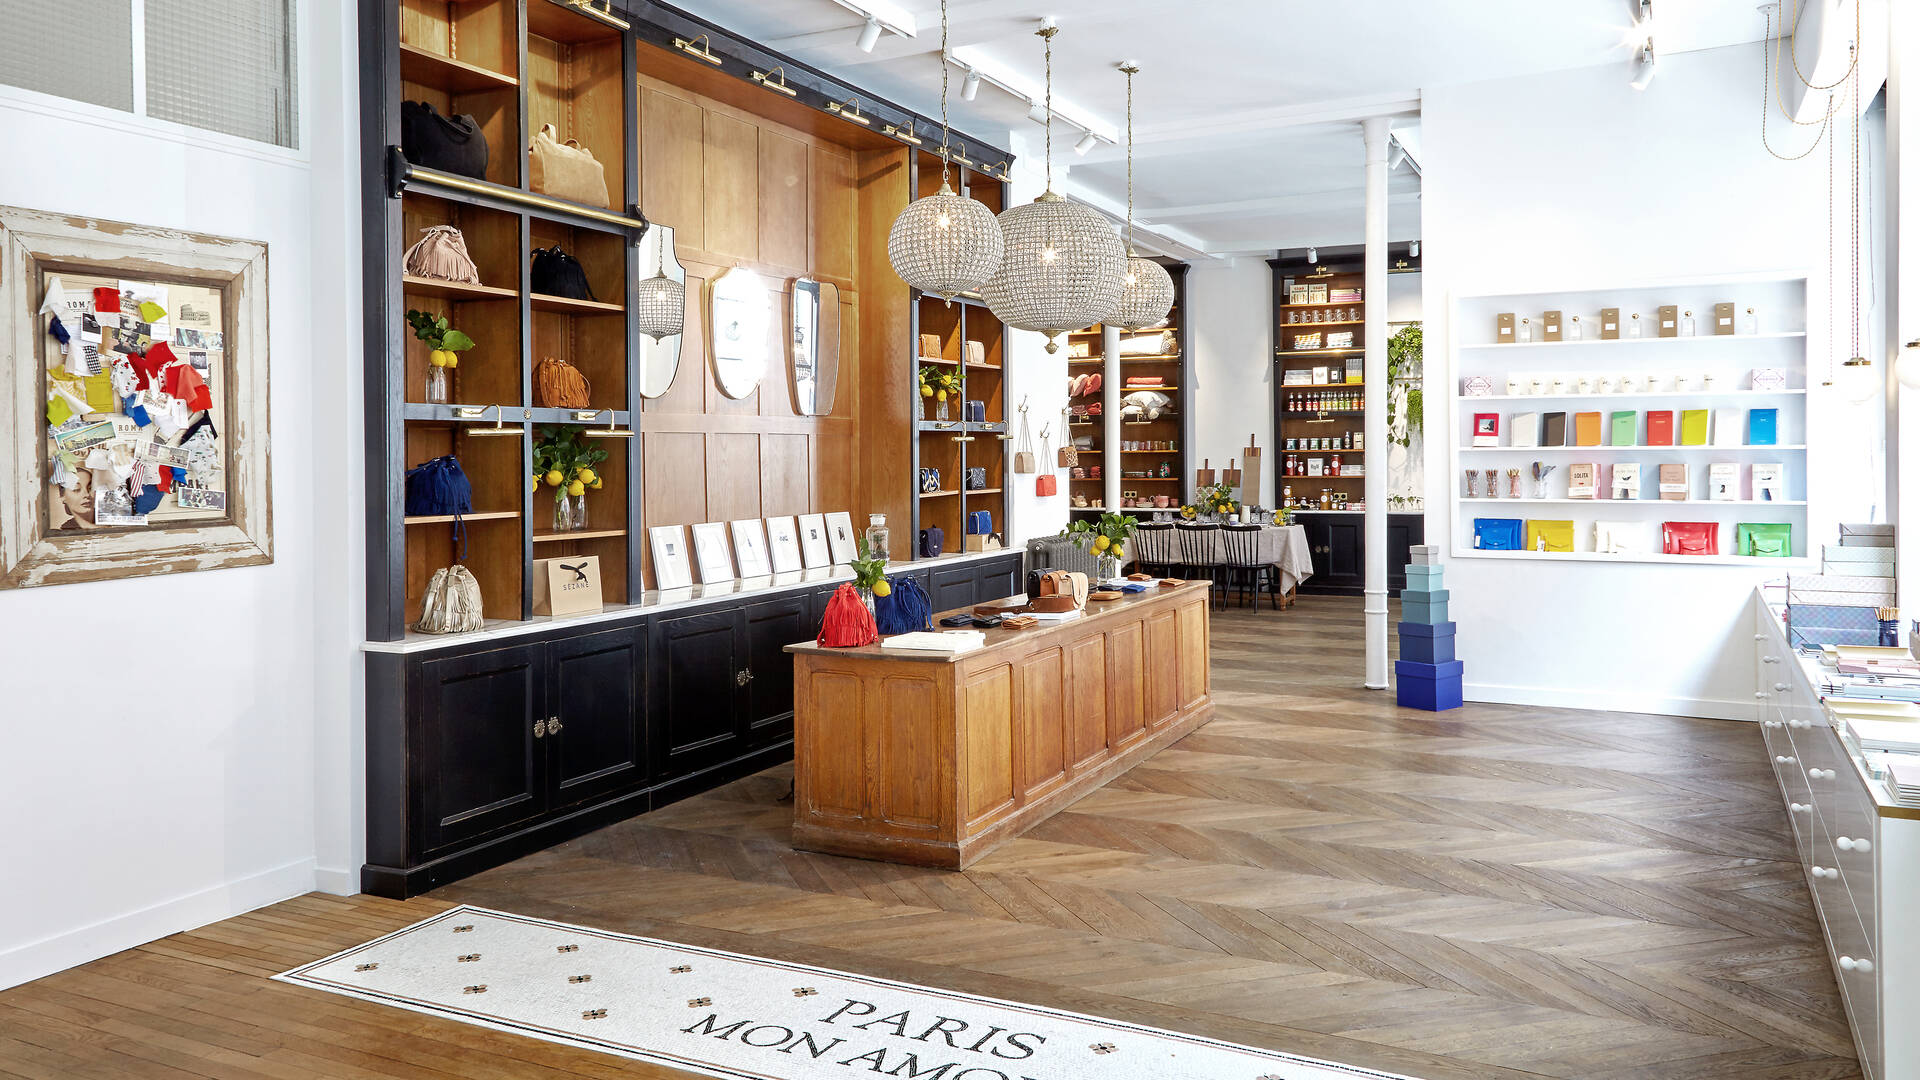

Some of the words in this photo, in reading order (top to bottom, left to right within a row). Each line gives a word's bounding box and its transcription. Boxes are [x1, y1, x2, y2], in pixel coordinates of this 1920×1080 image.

[680, 1013, 847, 1059] MON
[837, 1047, 1037, 1080] AMO
[818, 999, 1046, 1059] PARIS
